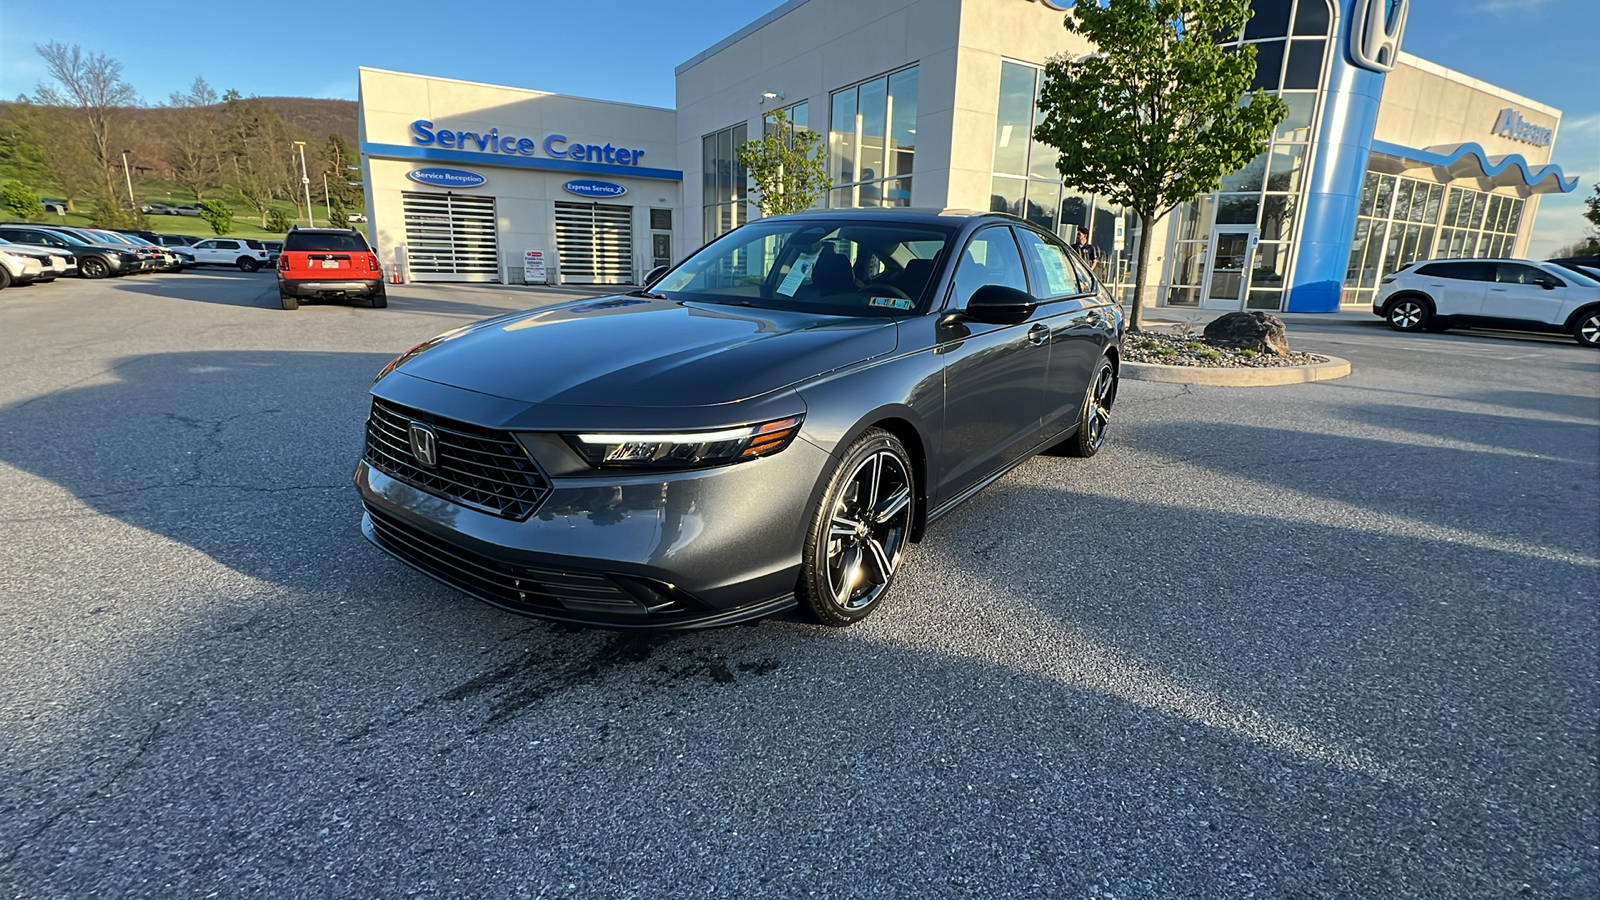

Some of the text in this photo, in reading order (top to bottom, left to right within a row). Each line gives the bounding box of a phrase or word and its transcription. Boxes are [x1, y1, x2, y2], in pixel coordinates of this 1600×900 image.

[411, 119, 645, 165] Service Center
[415, 171, 482, 183] Service Reception
[567, 183, 614, 193] Express Service
